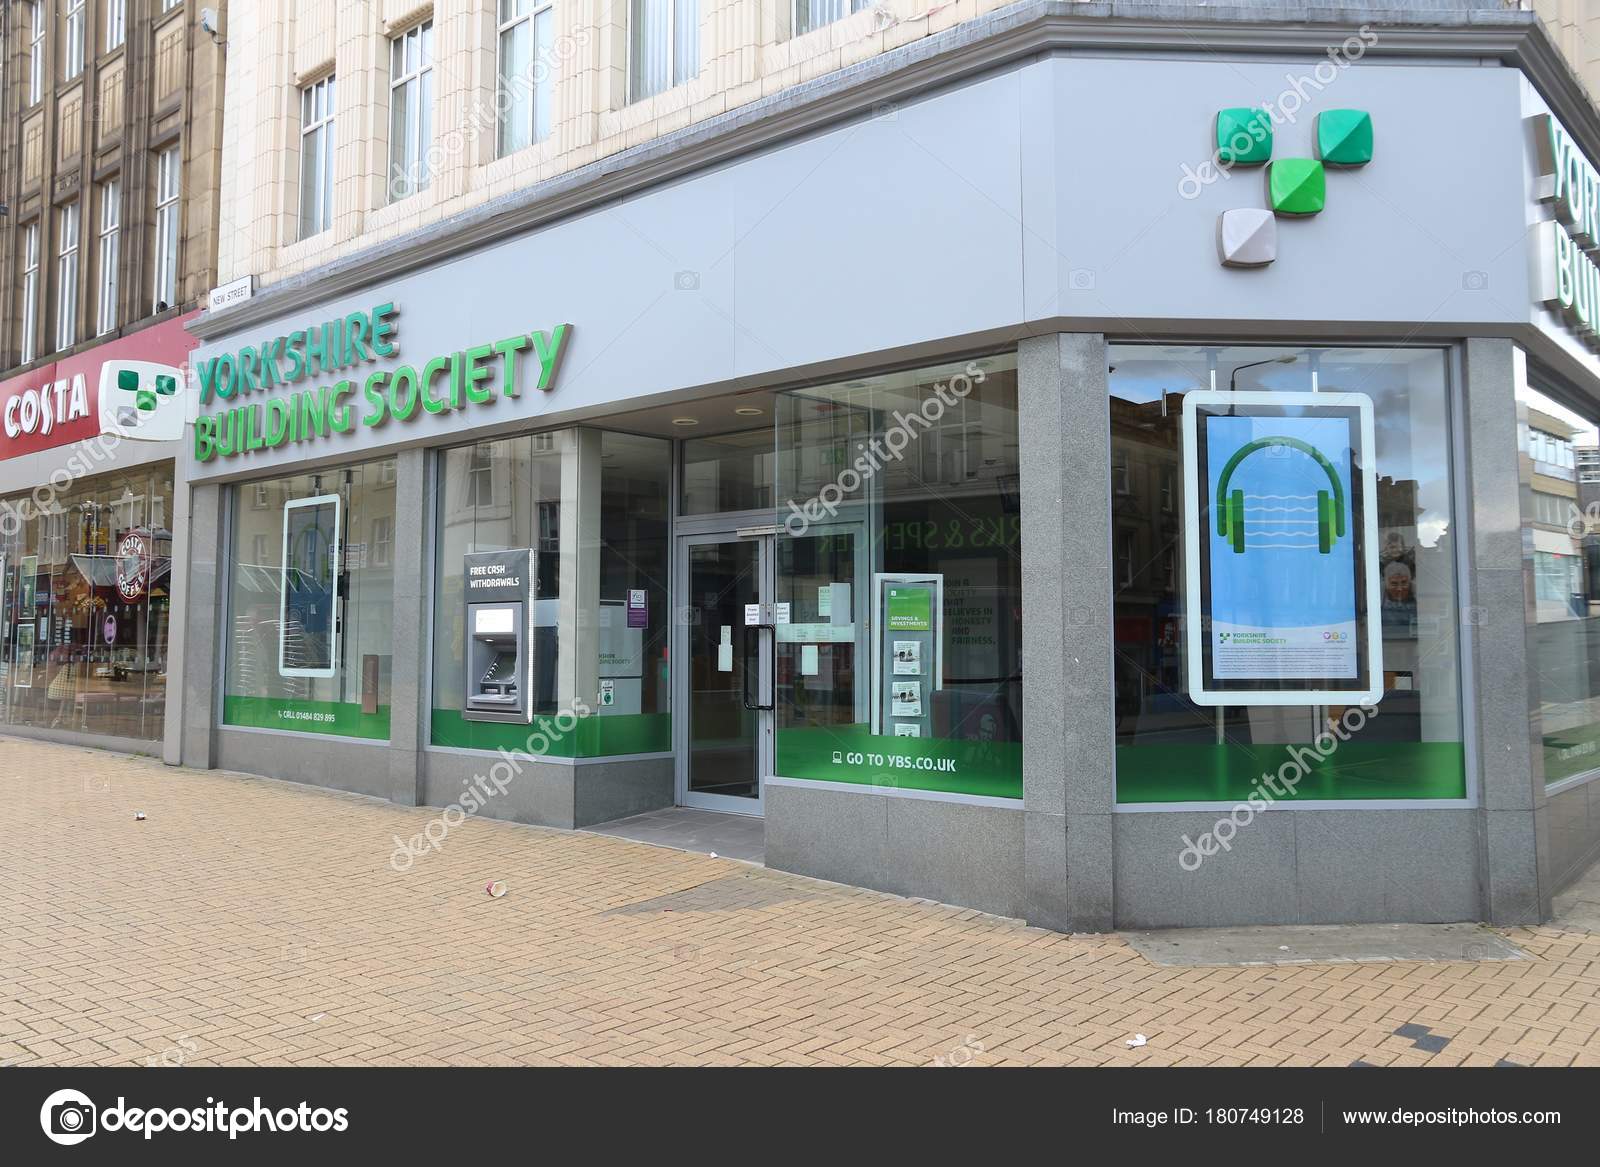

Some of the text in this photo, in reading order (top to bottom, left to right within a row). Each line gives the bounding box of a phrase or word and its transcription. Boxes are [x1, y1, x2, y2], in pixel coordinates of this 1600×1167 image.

[1546, 114, 1600, 248] YOR
[213, 285, 248, 305] NEW STREET
[196, 301, 396, 405] YORKSHIRE
[194, 323, 573, 463] BUILDING SOCIETY
[4, 373, 89, 439] COSTA
[121, 536, 142, 556] COSTA
[470, 565, 505, 576] FREE CASH
[118, 573, 144, 596] COFFEE
[470, 577, 520, 588] WITHDRAWALS
[283, 710, 335, 722] CALL 01484 829 895
[846, 752, 956, 772] GO TO YBS.CO.UK
